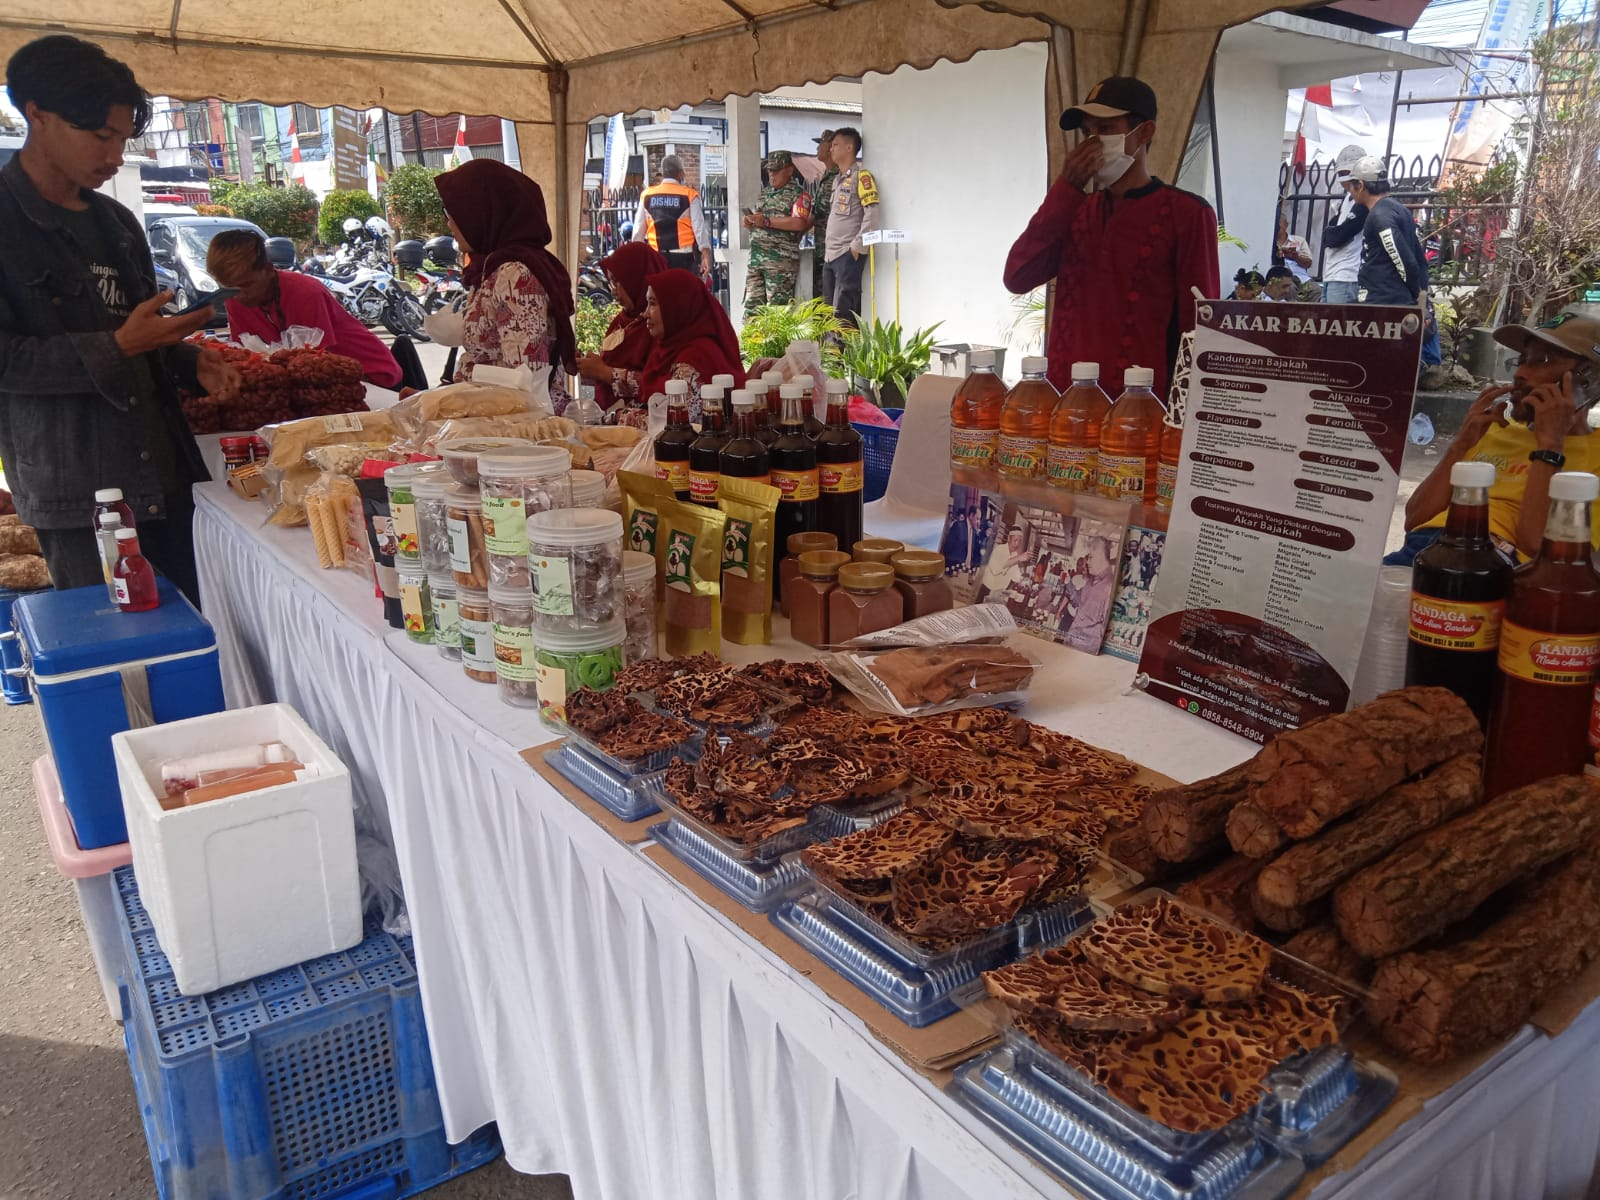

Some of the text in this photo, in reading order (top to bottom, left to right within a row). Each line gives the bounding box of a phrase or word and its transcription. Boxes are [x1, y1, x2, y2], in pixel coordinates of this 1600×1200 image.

[650, 196, 680, 208] DISHUB
[1219, 313, 1403, 341] AKAR BAJAKAH
[1206, 351, 1309, 372] Kandungan Bajakah
[1215, 379, 1250, 390] Saponin
[1327, 392, 1371, 406] Alkaloid
[1206, 413, 1249, 427] Flavanoid
[1325, 416, 1364, 431] Fenolik
[1200, 453, 1243, 468] Terpenoid
[1319, 453, 1357, 468] Steroid
[1319, 483, 1347, 497] Tanin
[1204, 500, 1342, 541] Testimoni Penyakit Yang Diobati Dengan
[1233, 515, 1303, 540] Akar Bajakah
[1301, 546, 1332, 560] Payudara
[1411, 602, 1467, 624] KANDAGA
[1535, 654, 1584, 668] Madu Alam
[1533, 672, 1553, 682] MADU
[1554, 674, 1573, 683] ALAM
[1192, 674, 1204, 684] ada
[1204, 678, 1229, 694] Penyakit
[1228, 689, 1244, 702] yang
[1244, 694, 1260, 706] tidak
[1260, 701, 1274, 713] bisa
[1282, 711, 1301, 724] obati
[1201, 706, 1265, 744] 0858-8548-6904
